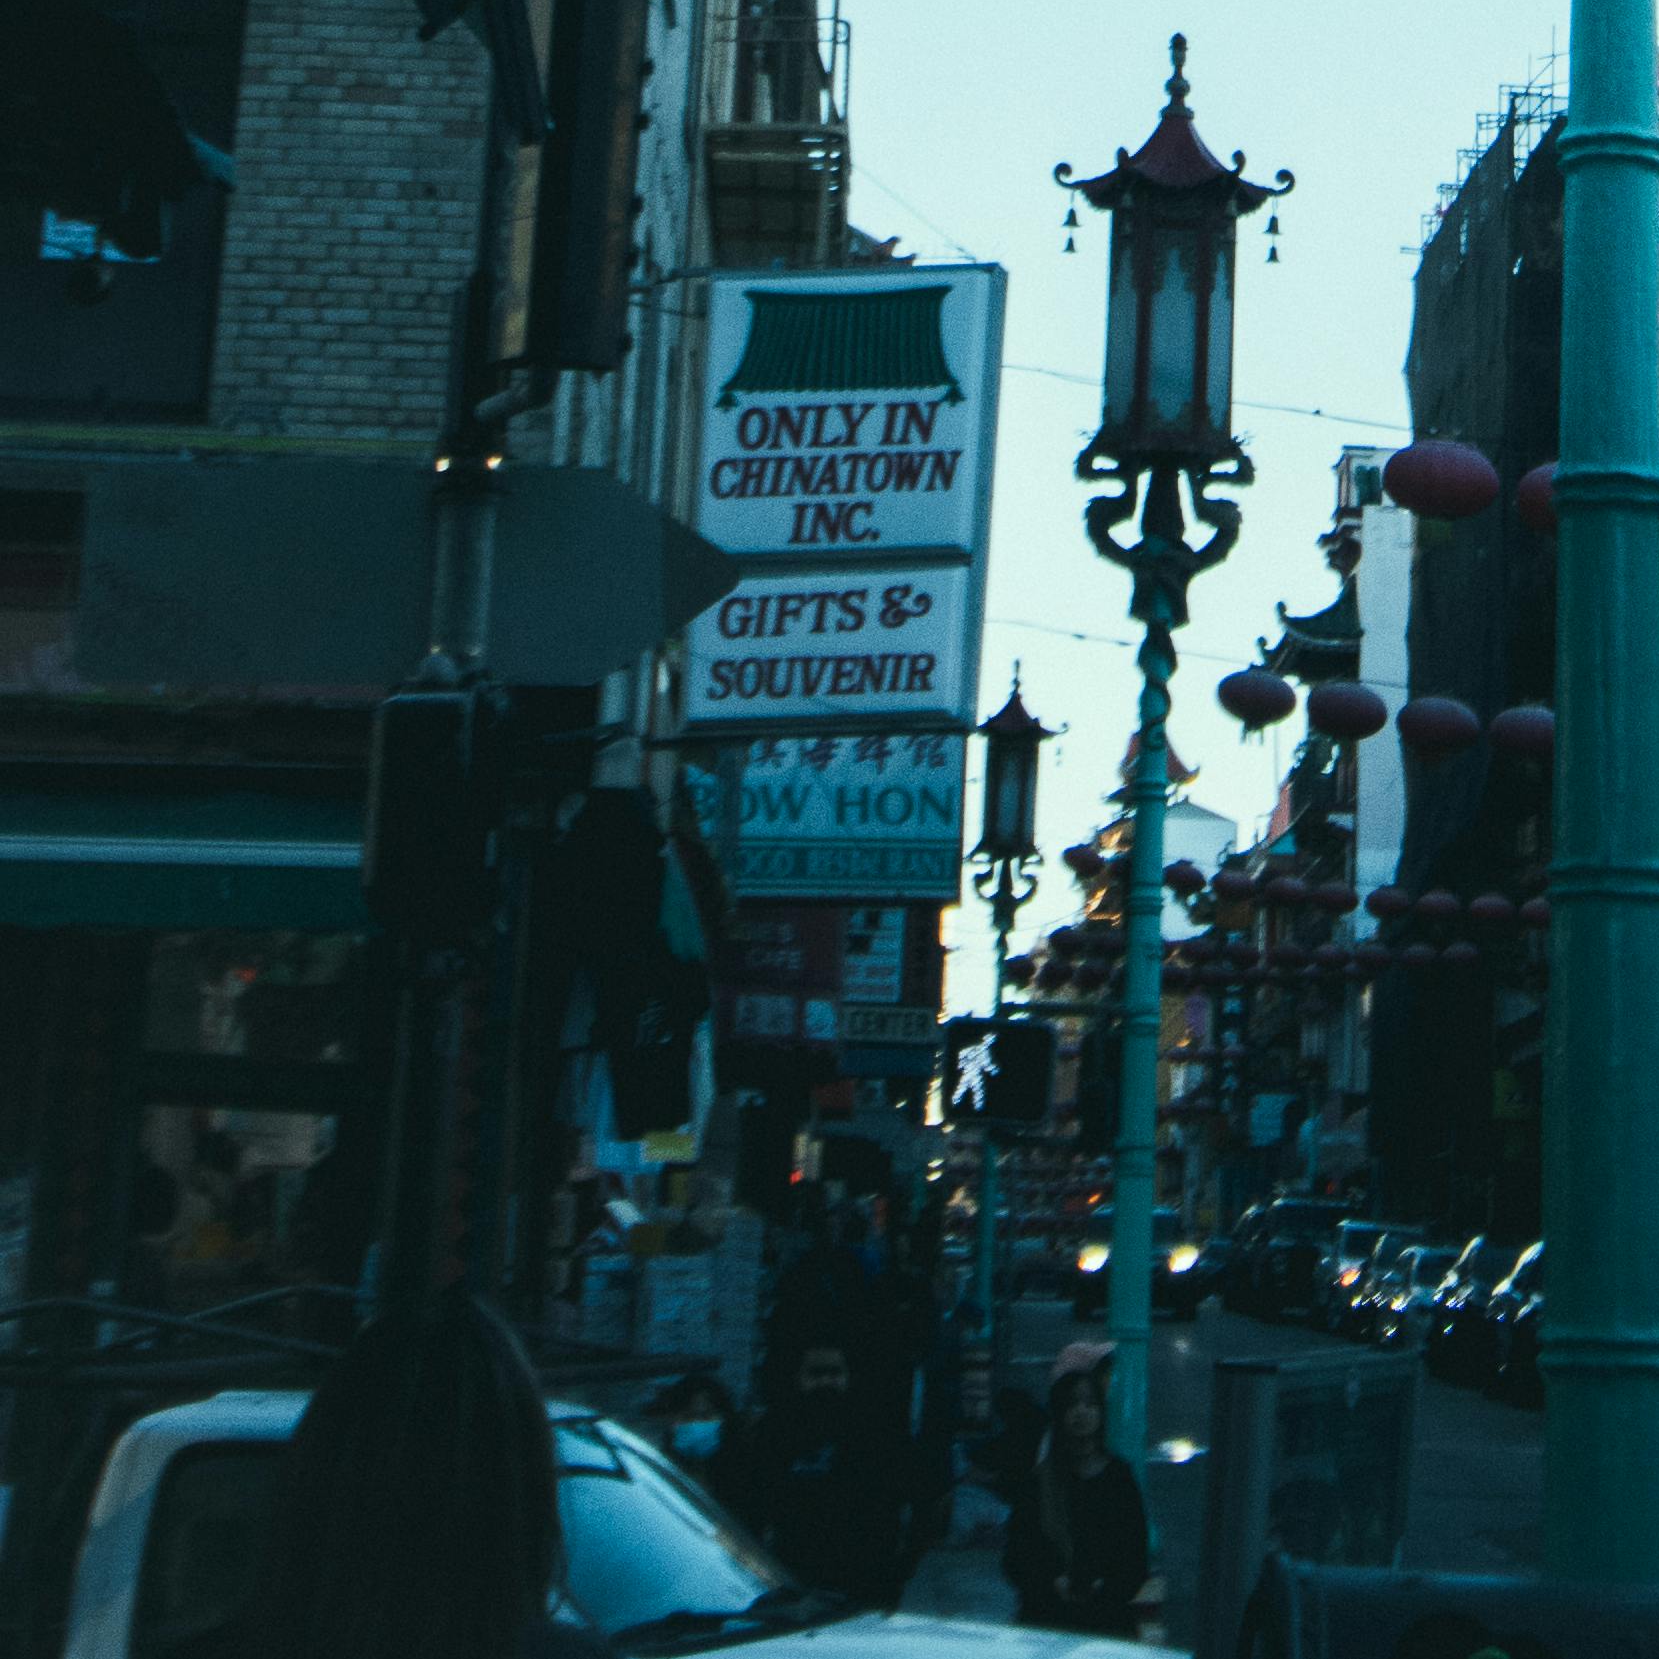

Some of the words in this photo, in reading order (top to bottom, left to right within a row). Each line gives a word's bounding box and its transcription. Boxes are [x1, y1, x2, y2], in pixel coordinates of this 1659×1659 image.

[737, 401, 874, 451] ONLY
[879, 400, 940, 446] IN
[709, 449, 962, 500] CHINATOWN
[788, 501, 881, 544] INC.
[718, 588, 867, 639] GIFTS
[879, 584, 933, 628] &
[706, 653, 936, 700] SOUVENIR
[834, 784, 955, 826] HON
